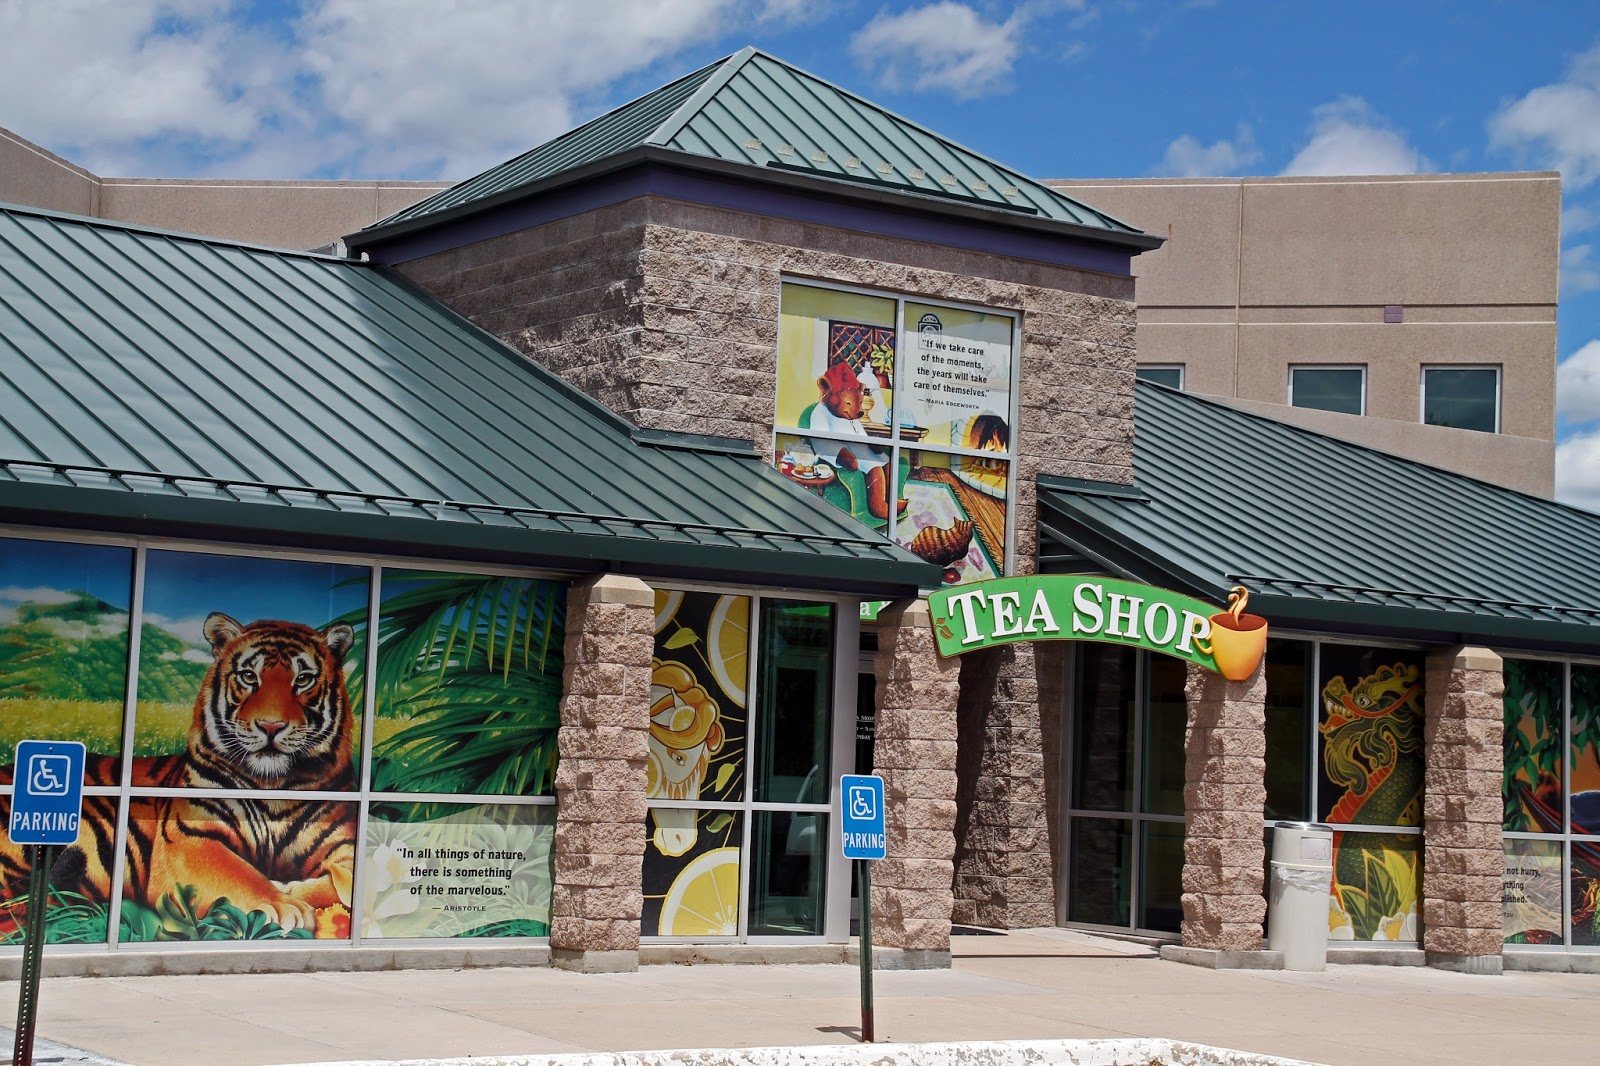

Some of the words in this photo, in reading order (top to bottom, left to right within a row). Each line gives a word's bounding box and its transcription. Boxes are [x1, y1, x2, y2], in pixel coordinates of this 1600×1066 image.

[922, 339, 933, 348] “If
[949, 343, 965, 353] take
[968, 347, 984, 355] care
[932, 355, 944, 363] the
[947, 358, 984, 371] moments,
[917, 367, 929, 375] the
[932, 370, 952, 379] years
[955, 373, 968, 381] will
[971, 374, 987, 383] take
[913, 381, 930, 389] care
[933, 383, 941, 391] of
[943, 385, 990, 398] themselves.”
[947, 589, 1060, 645] TEA
[1072, 582, 1211, 654] SHOP
[12, 811, 78, 831] PARKING
[844, 832, 884, 848] PARKING
[397, 848, 414, 859] “In
[418, 848, 431, 859] all
[435, 849, 469, 861] things
[473, 849, 485, 859] of
[488, 850, 526, 861] nature,
[410, 867, 439, 877] there
[443, 867, 452, 877] is
[456, 867, 512, 880] something
[1507, 867, 1518, 875] not
[1521, 867, 1541, 878] hurry,
[410, 885, 423, 895] of
[426, 885, 444, 895] the
[448, 885, 510, 896] marvelous.”
